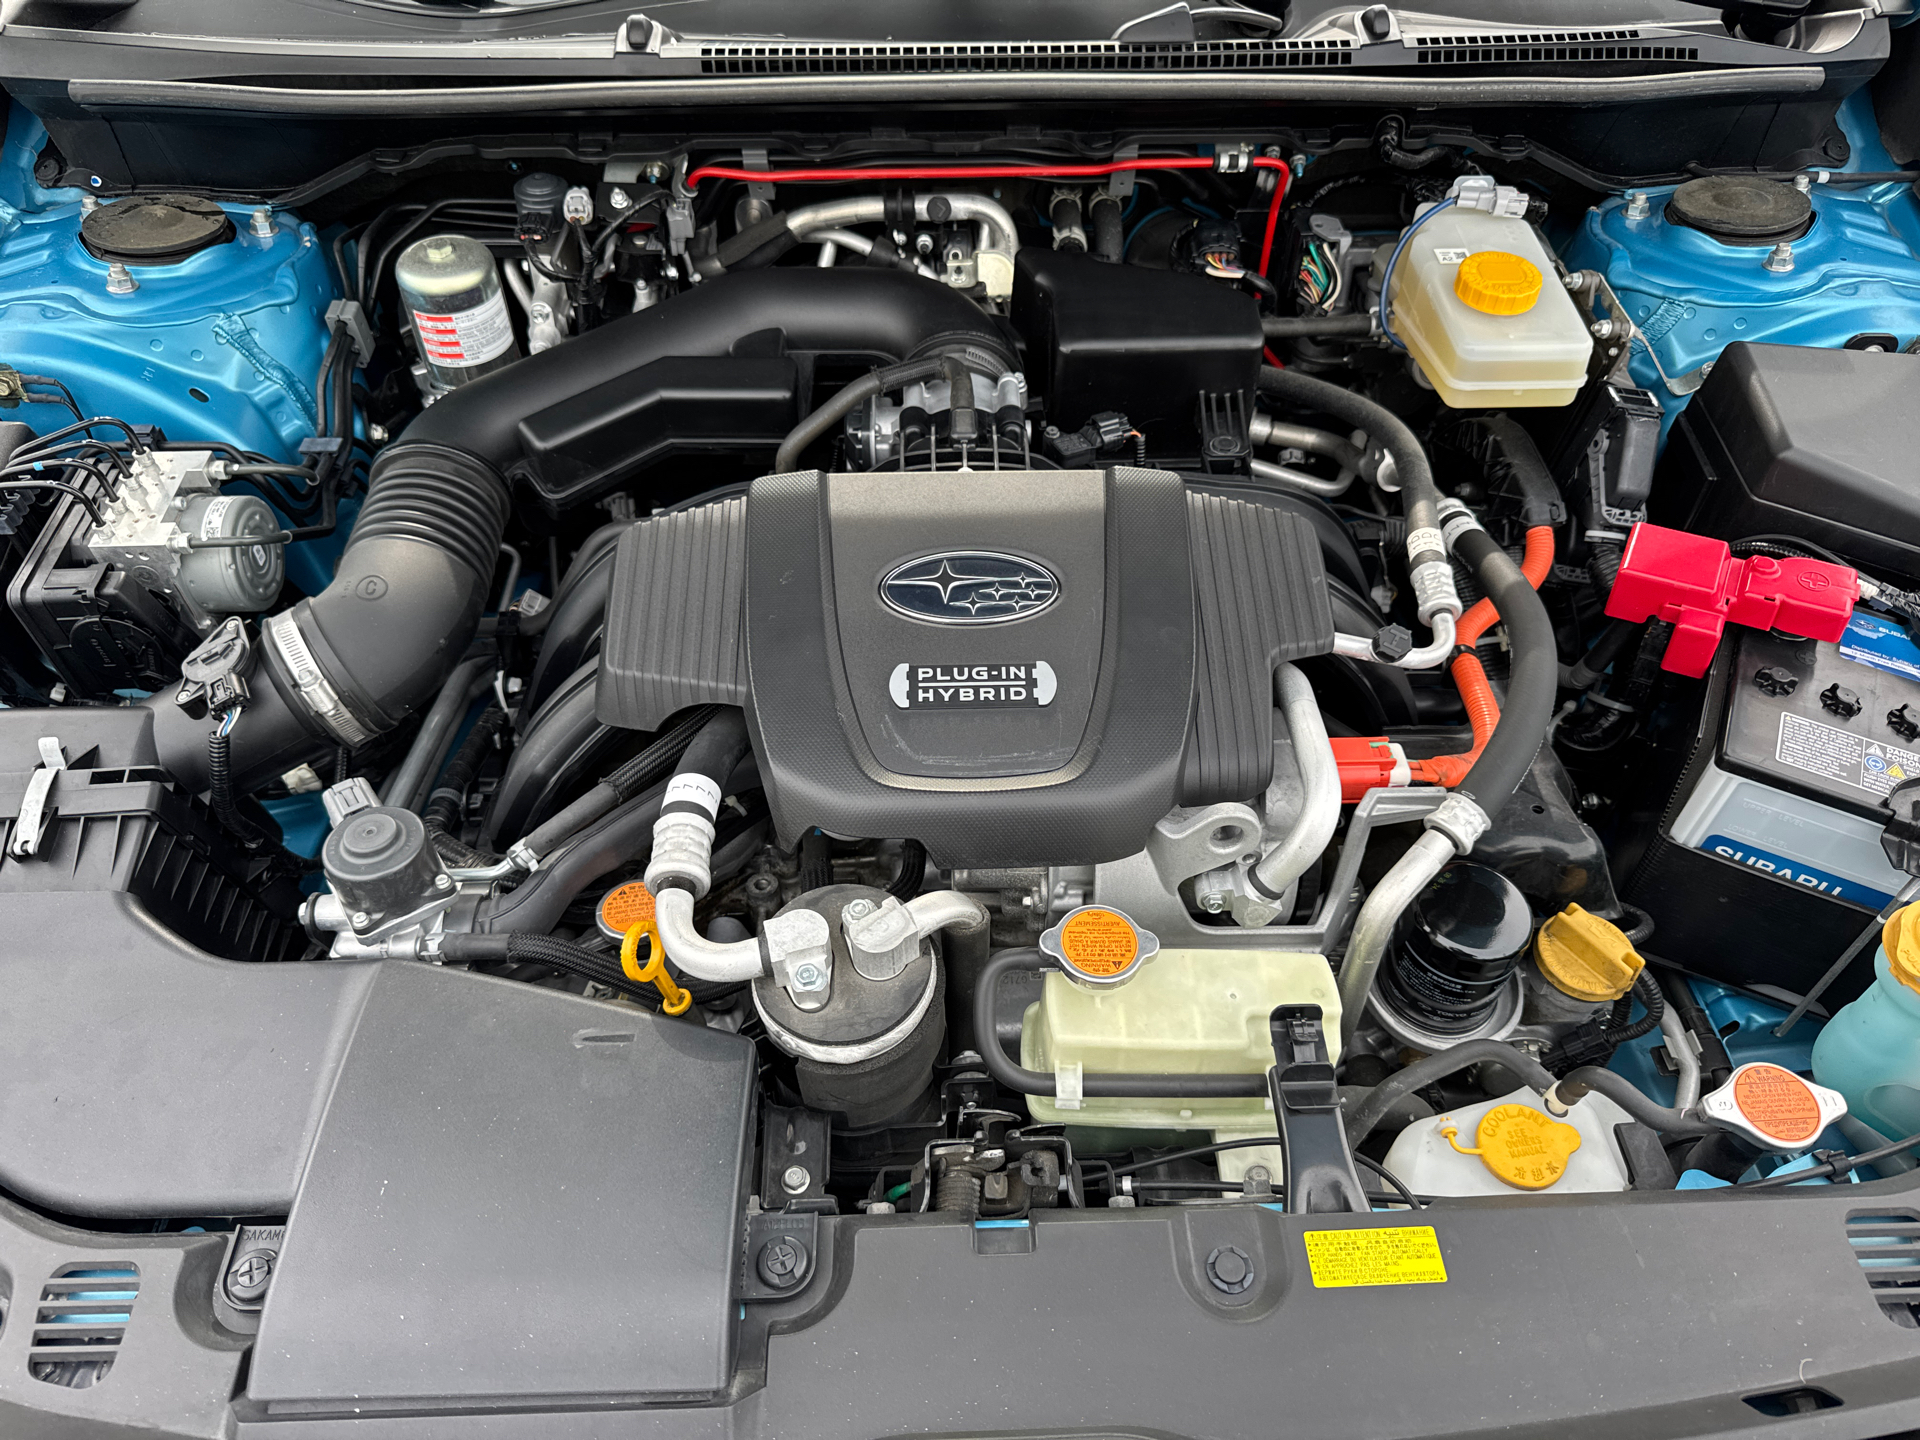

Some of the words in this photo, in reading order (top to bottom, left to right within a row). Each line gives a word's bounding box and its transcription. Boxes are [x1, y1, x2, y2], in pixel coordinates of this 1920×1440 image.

[918, 666, 1026, 681] PLUG-IN
[918, 687, 1027, 702] HYBRID
[1742, 802, 1772, 816] UPPER
[1778, 814, 1804, 828] LEVEL
[1728, 823, 1757, 837] LOWER
[1763, 835, 1788, 849] LEVEL
[1436, 1009, 1467, 1018] TOKYO
[1756, 1074, 1786, 1083] WARNING
[1482, 1107, 1553, 1138] COOLANT
[1507, 1127, 1528, 1140] SEE
[1505, 1135, 1543, 1149] OWNERS
[1508, 1145, 1548, 1159] MANUAL
[242, 1229, 286, 1241] SAKAM
[1330, 1231, 1352, 1240] CAUTION
[1354, 1230, 1381, 1239] ATTENTION
